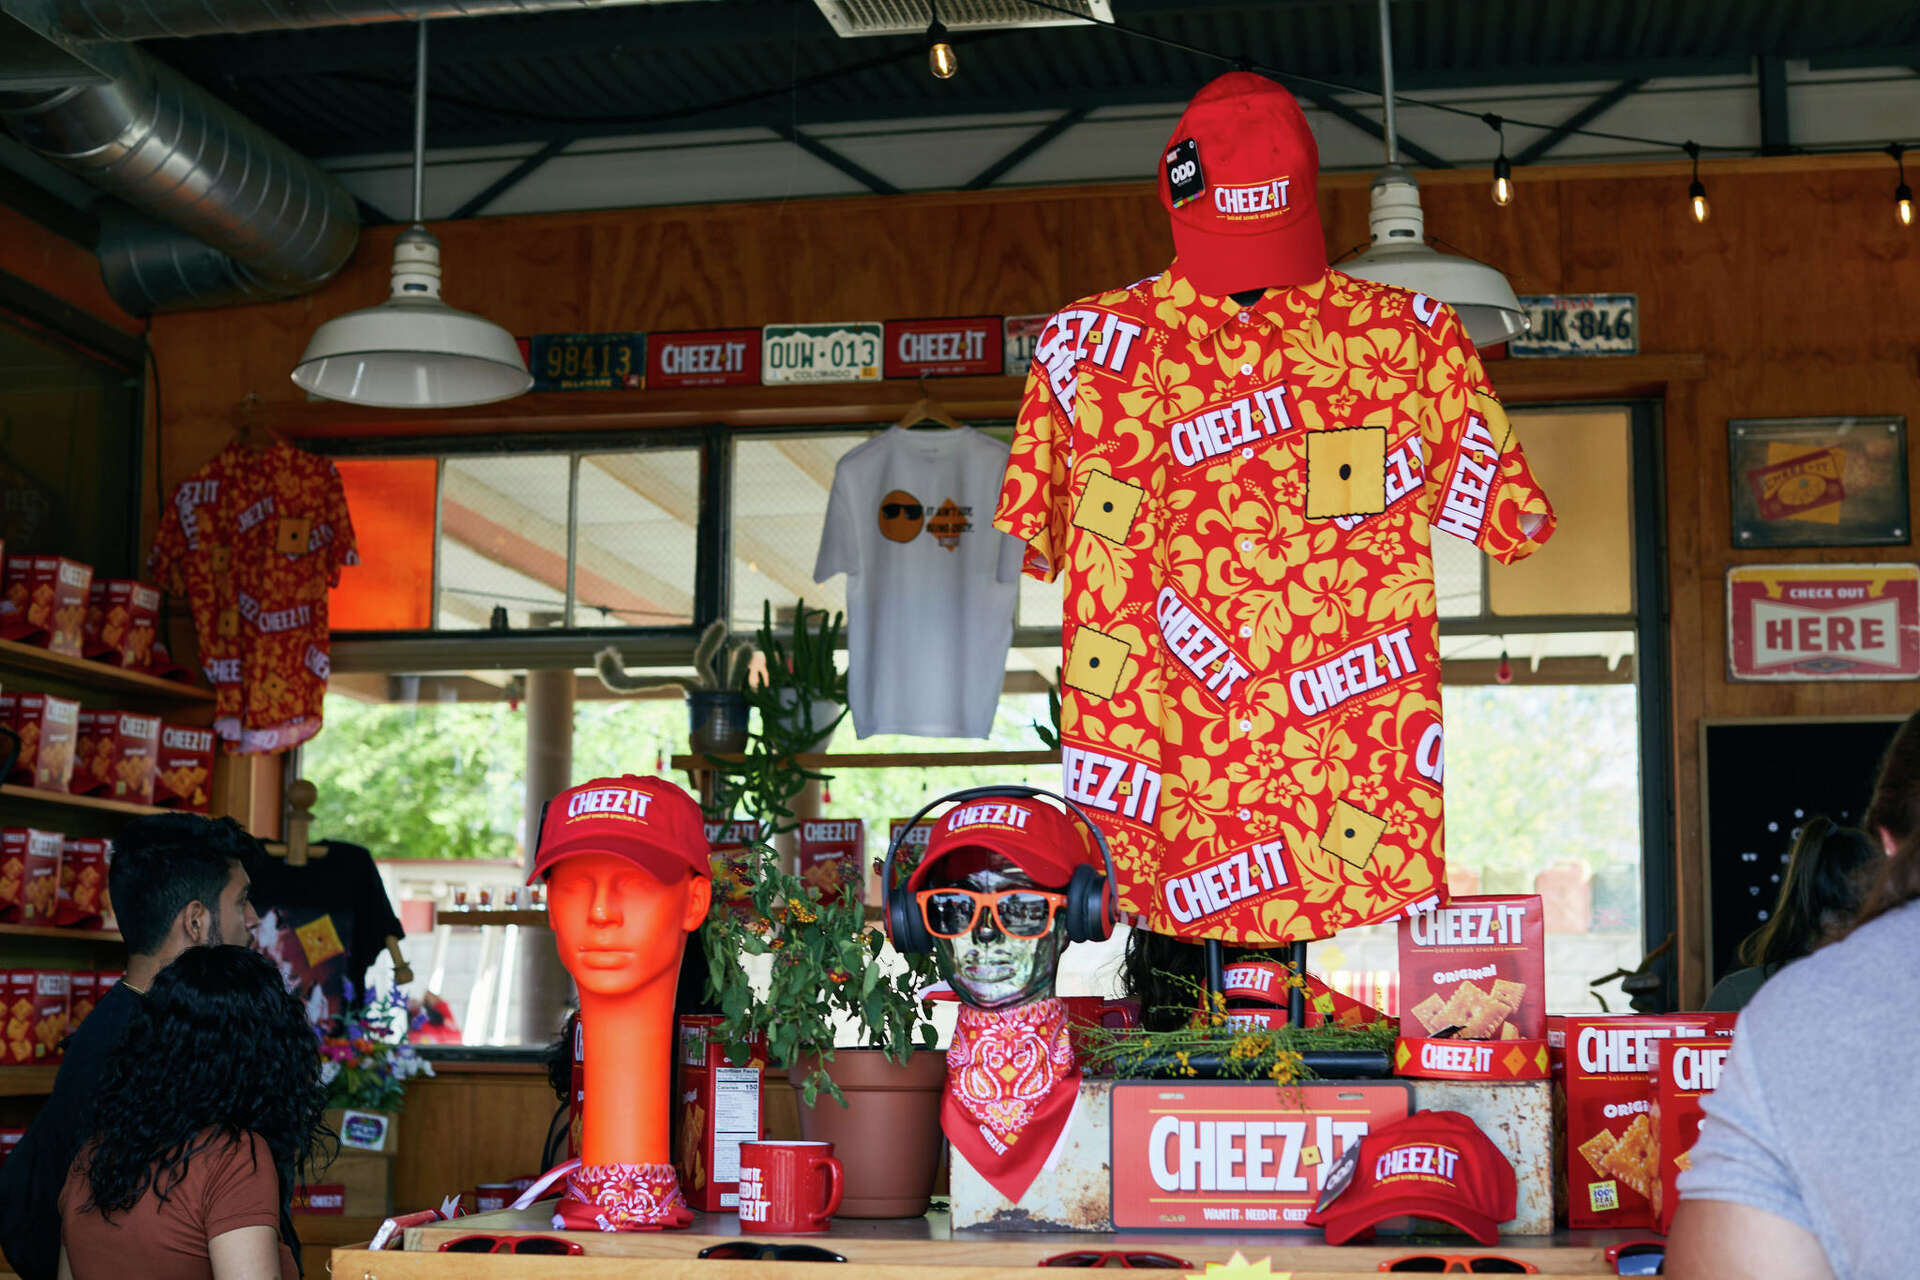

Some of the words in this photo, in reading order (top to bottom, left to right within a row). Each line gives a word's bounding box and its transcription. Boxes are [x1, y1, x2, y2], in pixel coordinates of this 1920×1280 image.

[1171, 160, 1196, 184] ODD
[1552, 298, 1594, 310] TEXAS
[547, 344, 631, 378] 98413
[1790, 588, 1835, 599] CHECK
[1837, 587, 1865, 598] OUT
[1765, 616, 1885, 651] HERE
